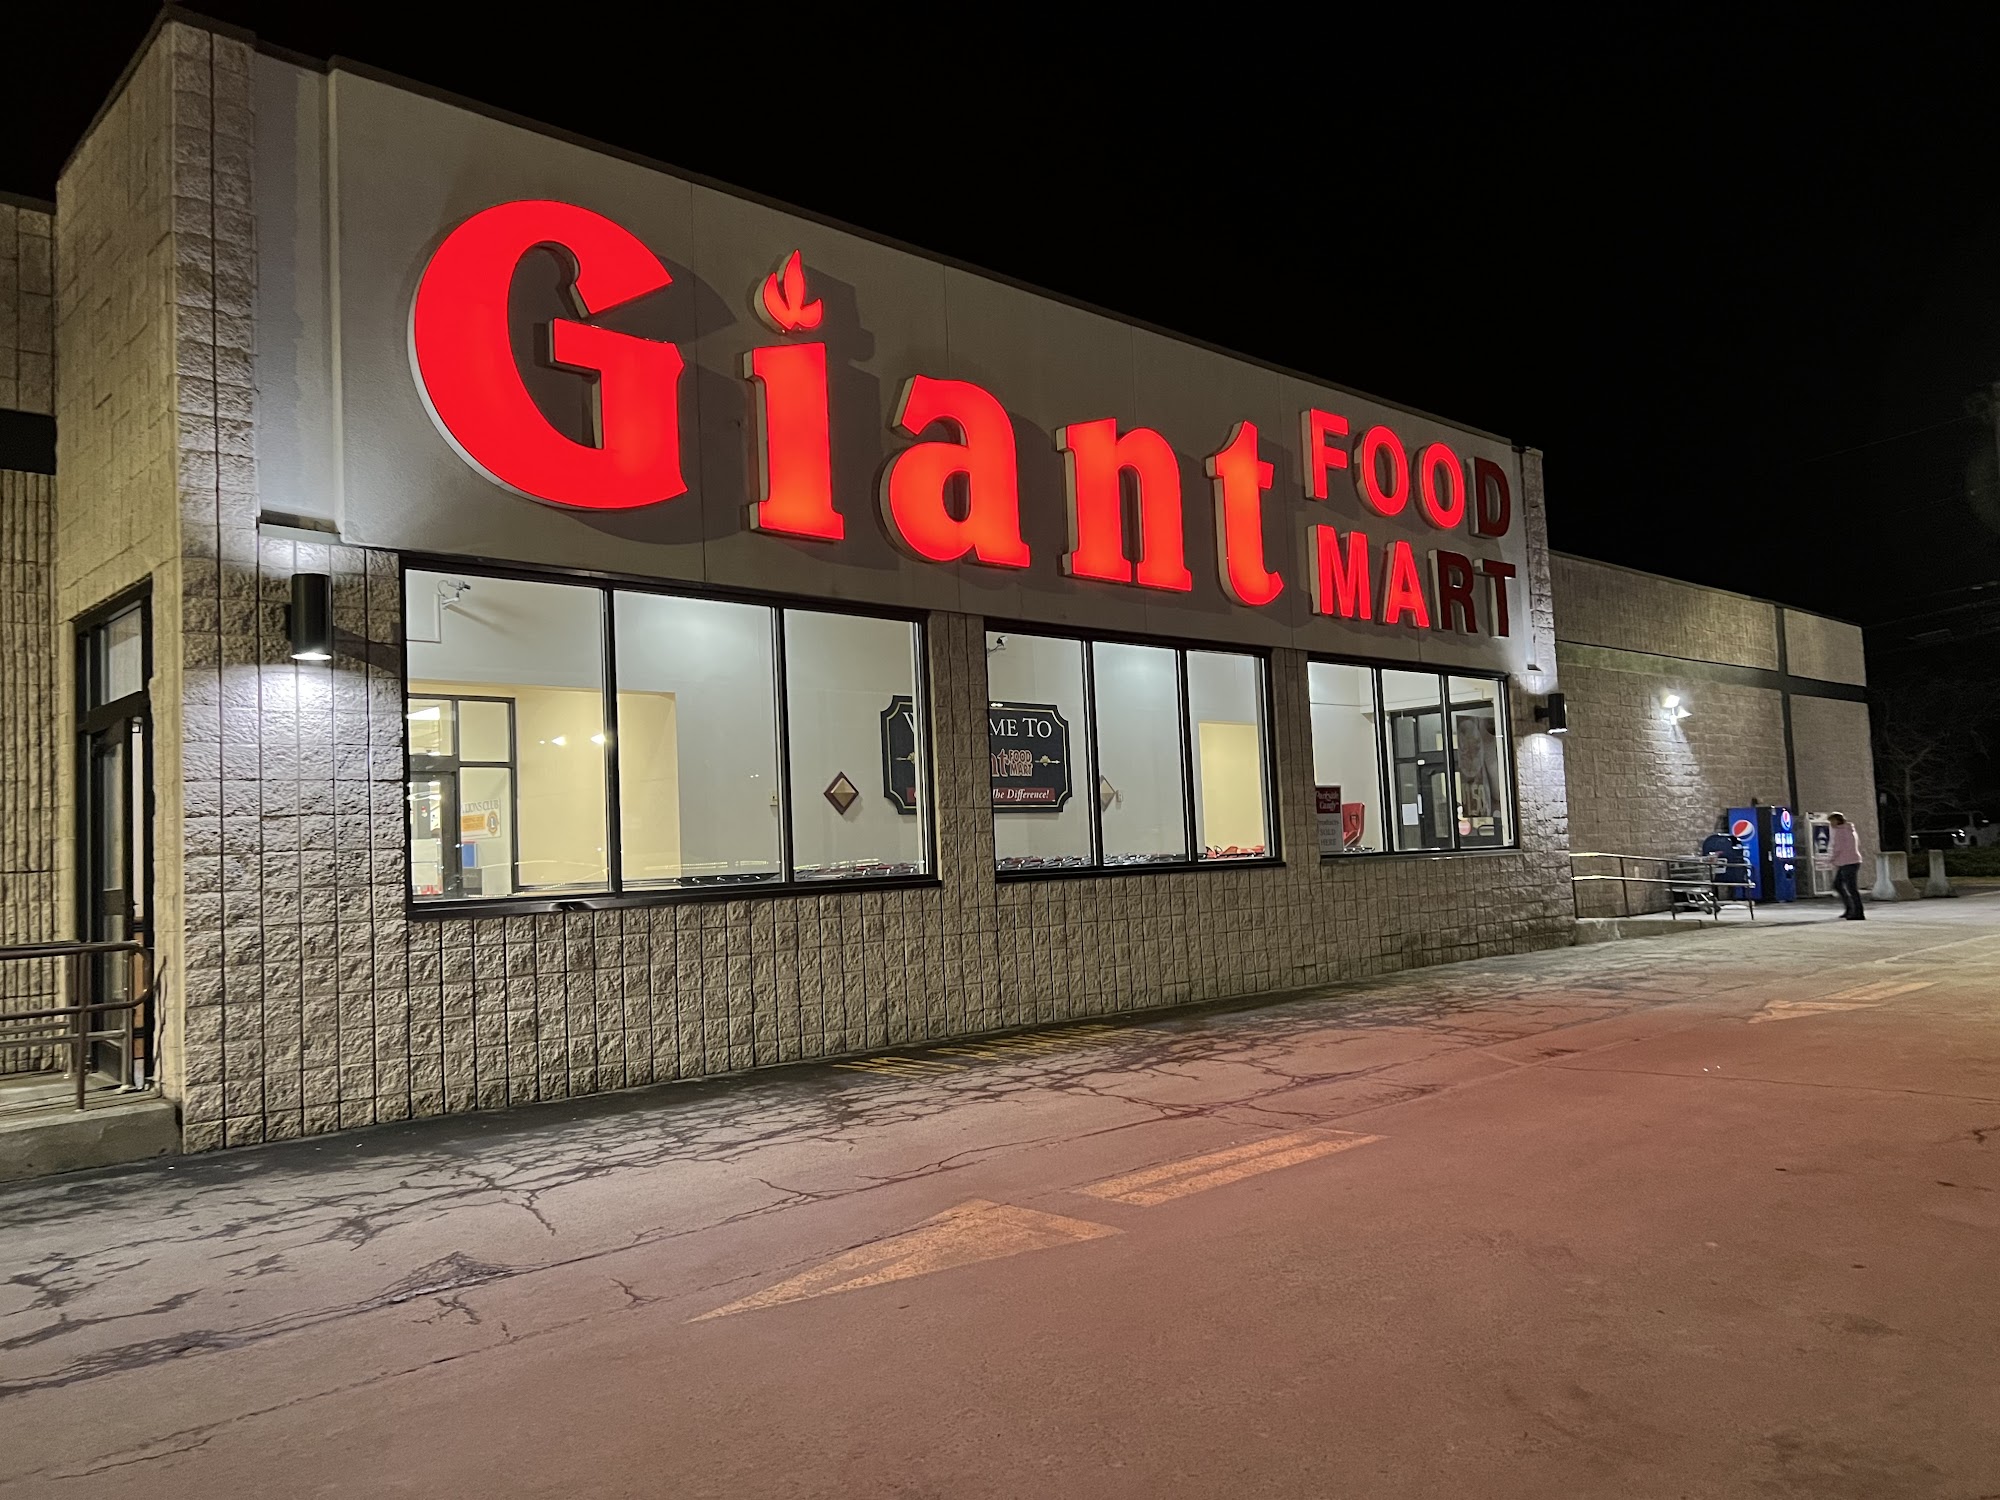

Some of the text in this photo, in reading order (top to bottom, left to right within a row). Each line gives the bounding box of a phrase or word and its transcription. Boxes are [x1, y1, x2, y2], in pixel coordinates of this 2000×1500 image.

[408, 199, 1285, 606] Giant
[1302, 408, 1512, 538] FOOD
[1308, 524, 1517, 639] MART
[1008, 749, 1033, 763] FOOD
[1009, 763, 1034, 777] MART
[1007, 788, 1050, 802] Difference!
